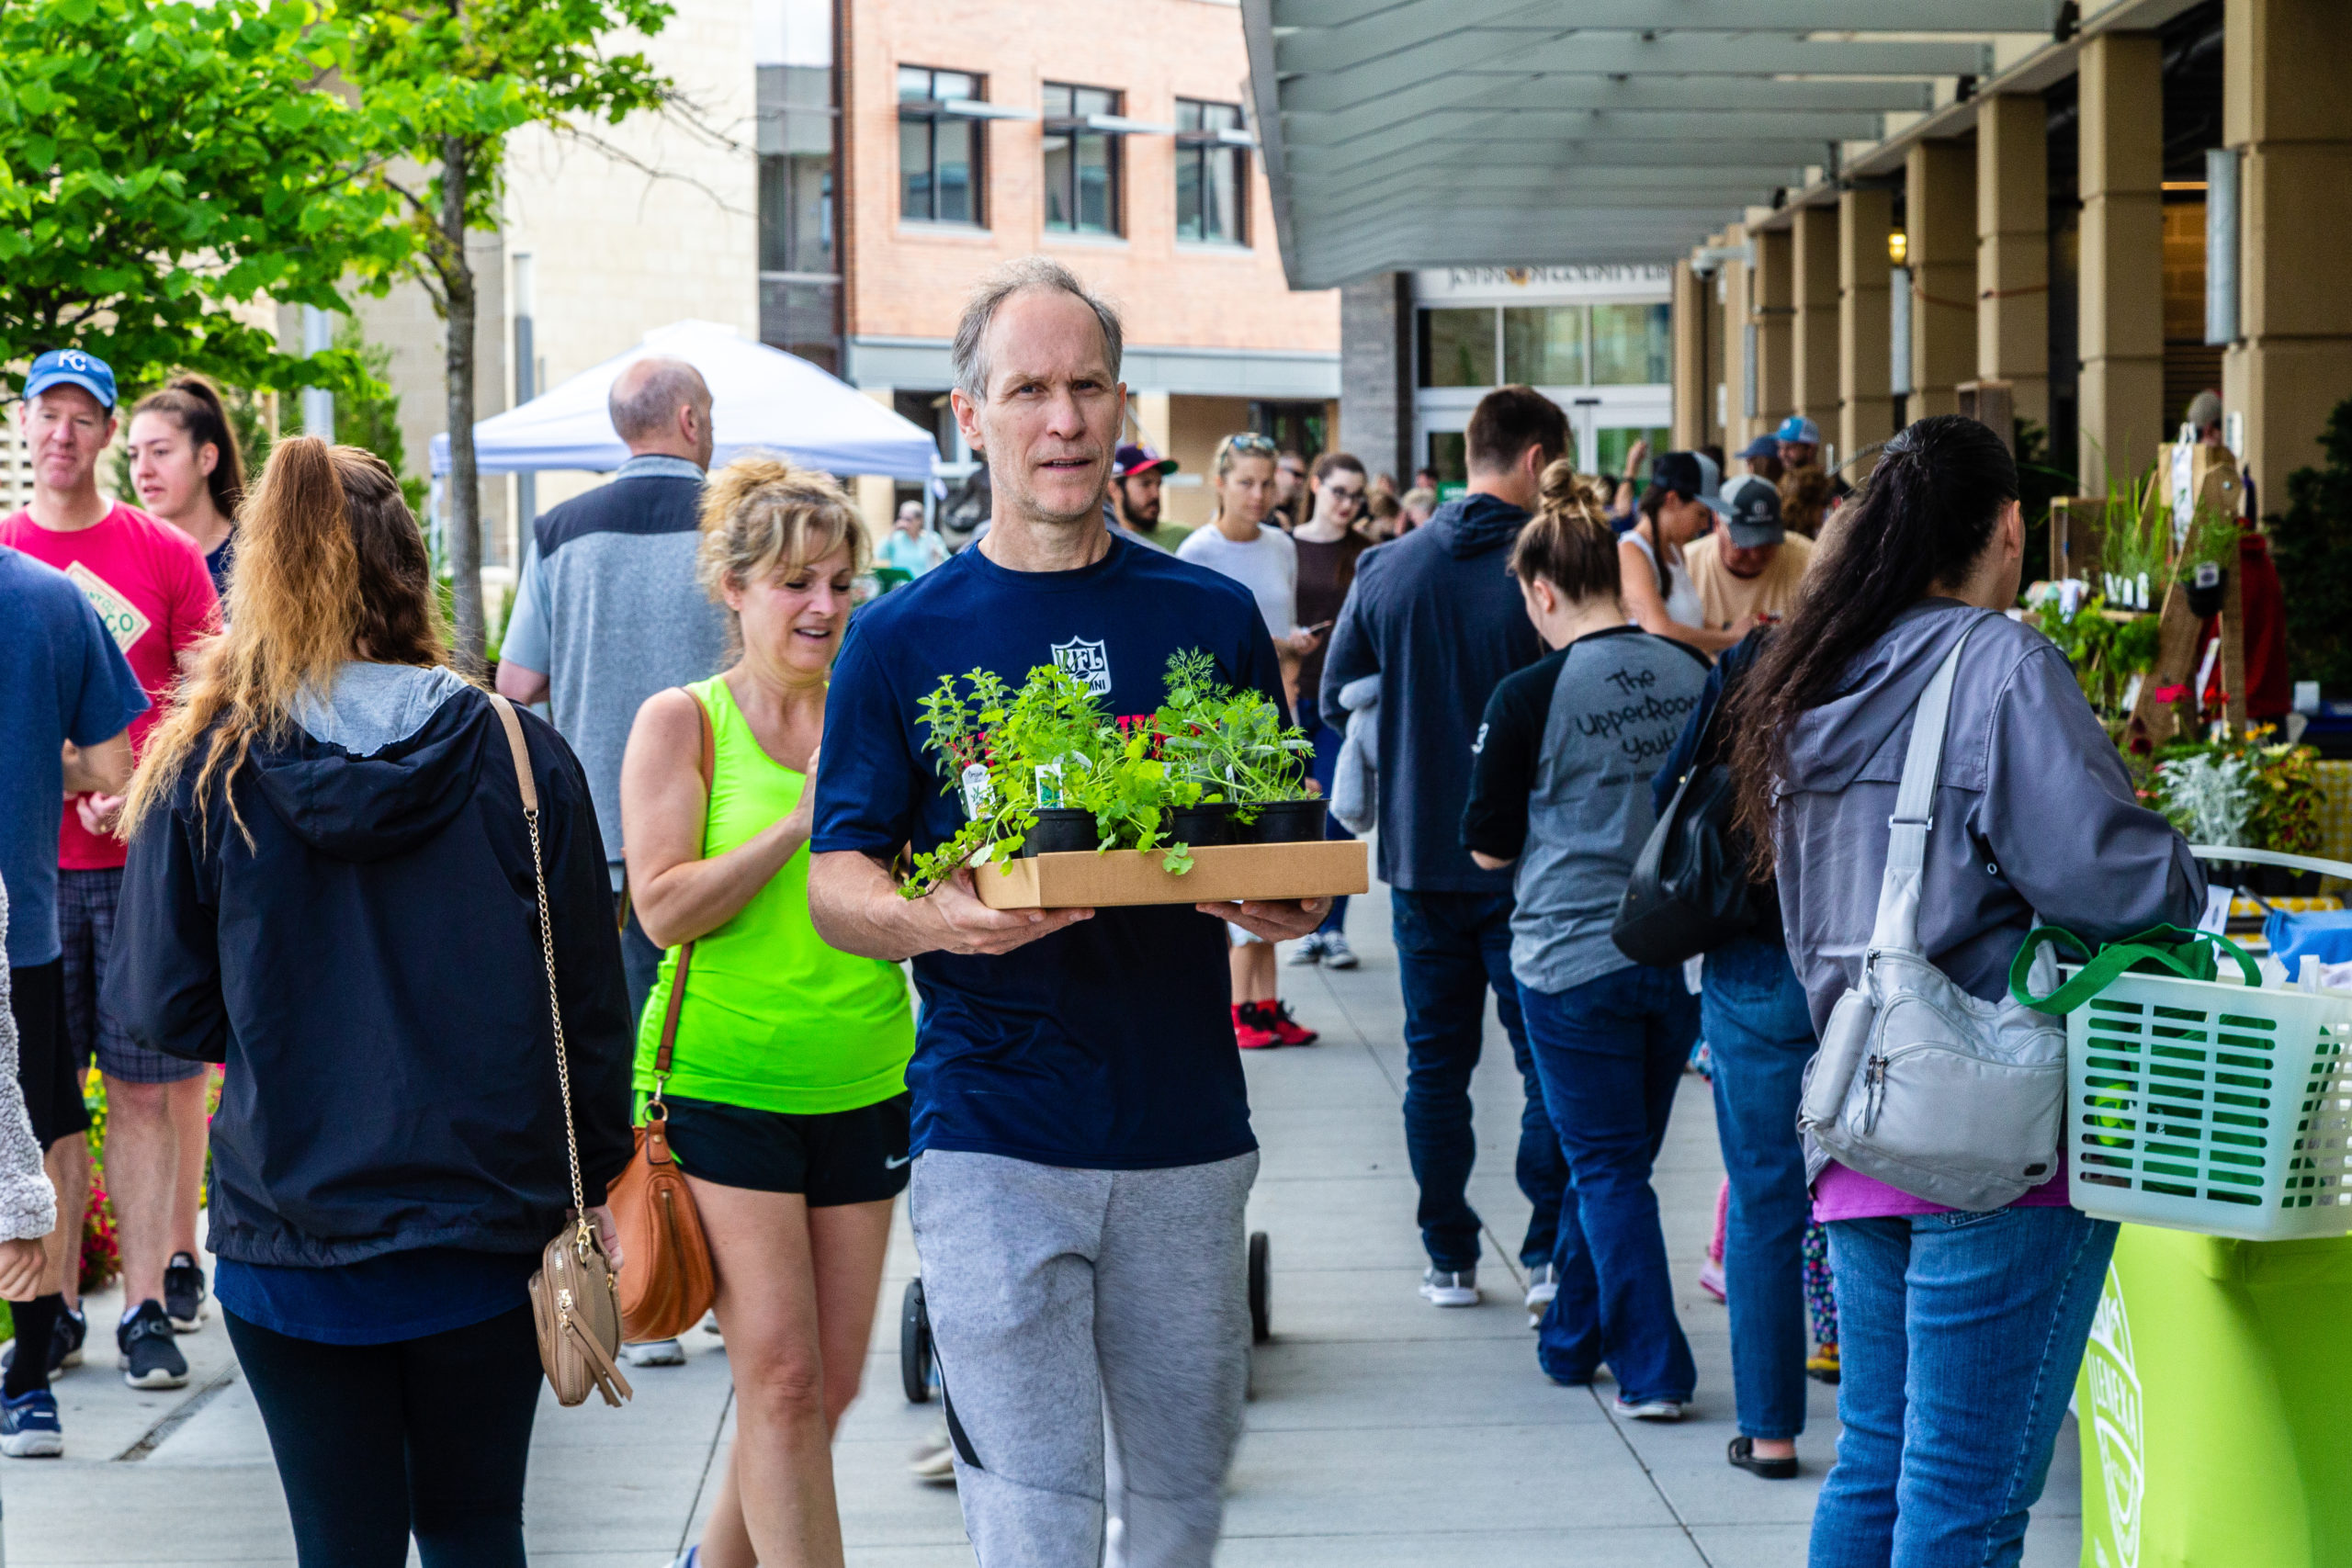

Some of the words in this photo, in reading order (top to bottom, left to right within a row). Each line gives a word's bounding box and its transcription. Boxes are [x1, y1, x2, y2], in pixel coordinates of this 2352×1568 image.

[58, 349, 86, 371] KC
[1604, 667, 1656, 696] The
[2087, 1350, 2139, 1452] LENEXA
